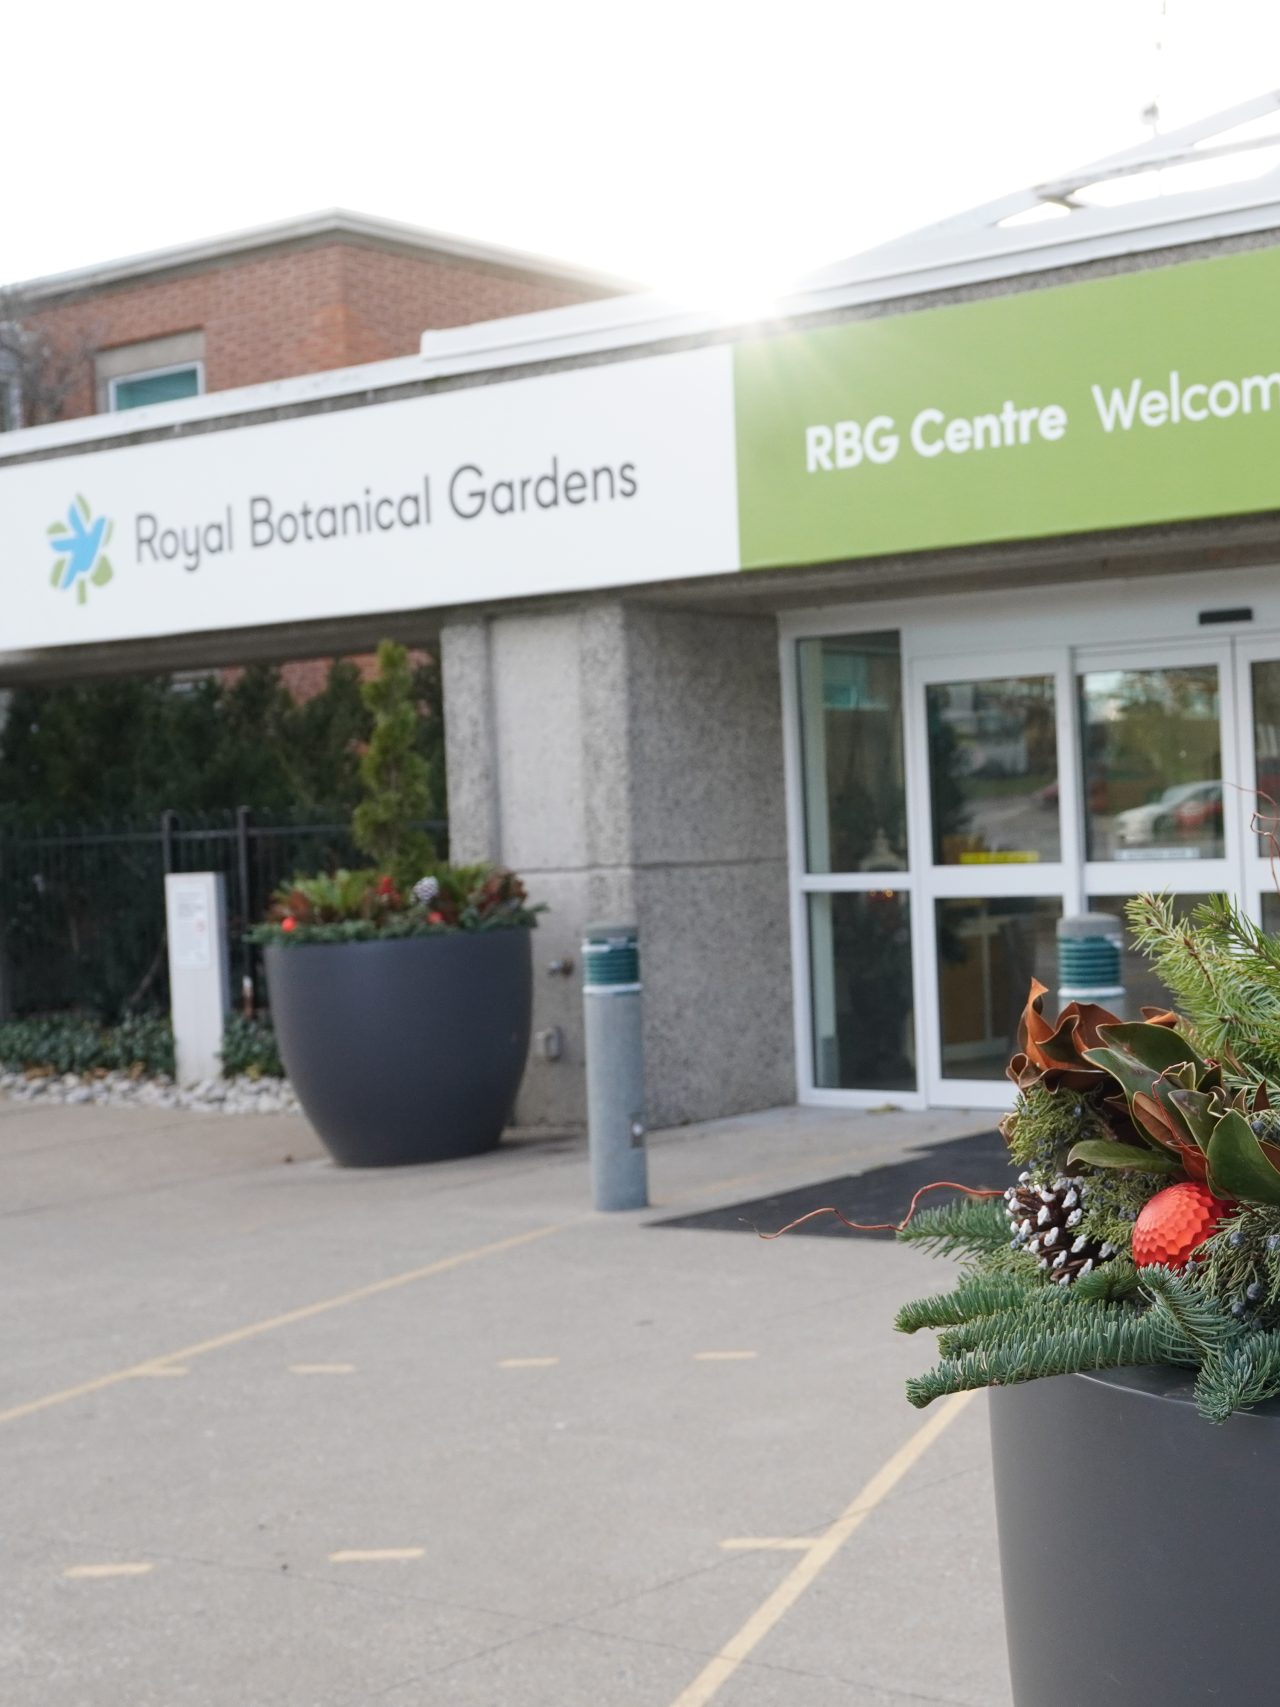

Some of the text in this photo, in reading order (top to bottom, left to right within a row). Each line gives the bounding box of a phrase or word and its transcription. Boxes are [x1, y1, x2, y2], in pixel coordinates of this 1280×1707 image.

[805, 415, 900, 473] RBG
[910, 400, 1067, 457] Centre
[134, 456, 638, 572] Royal Botanical Gardens
